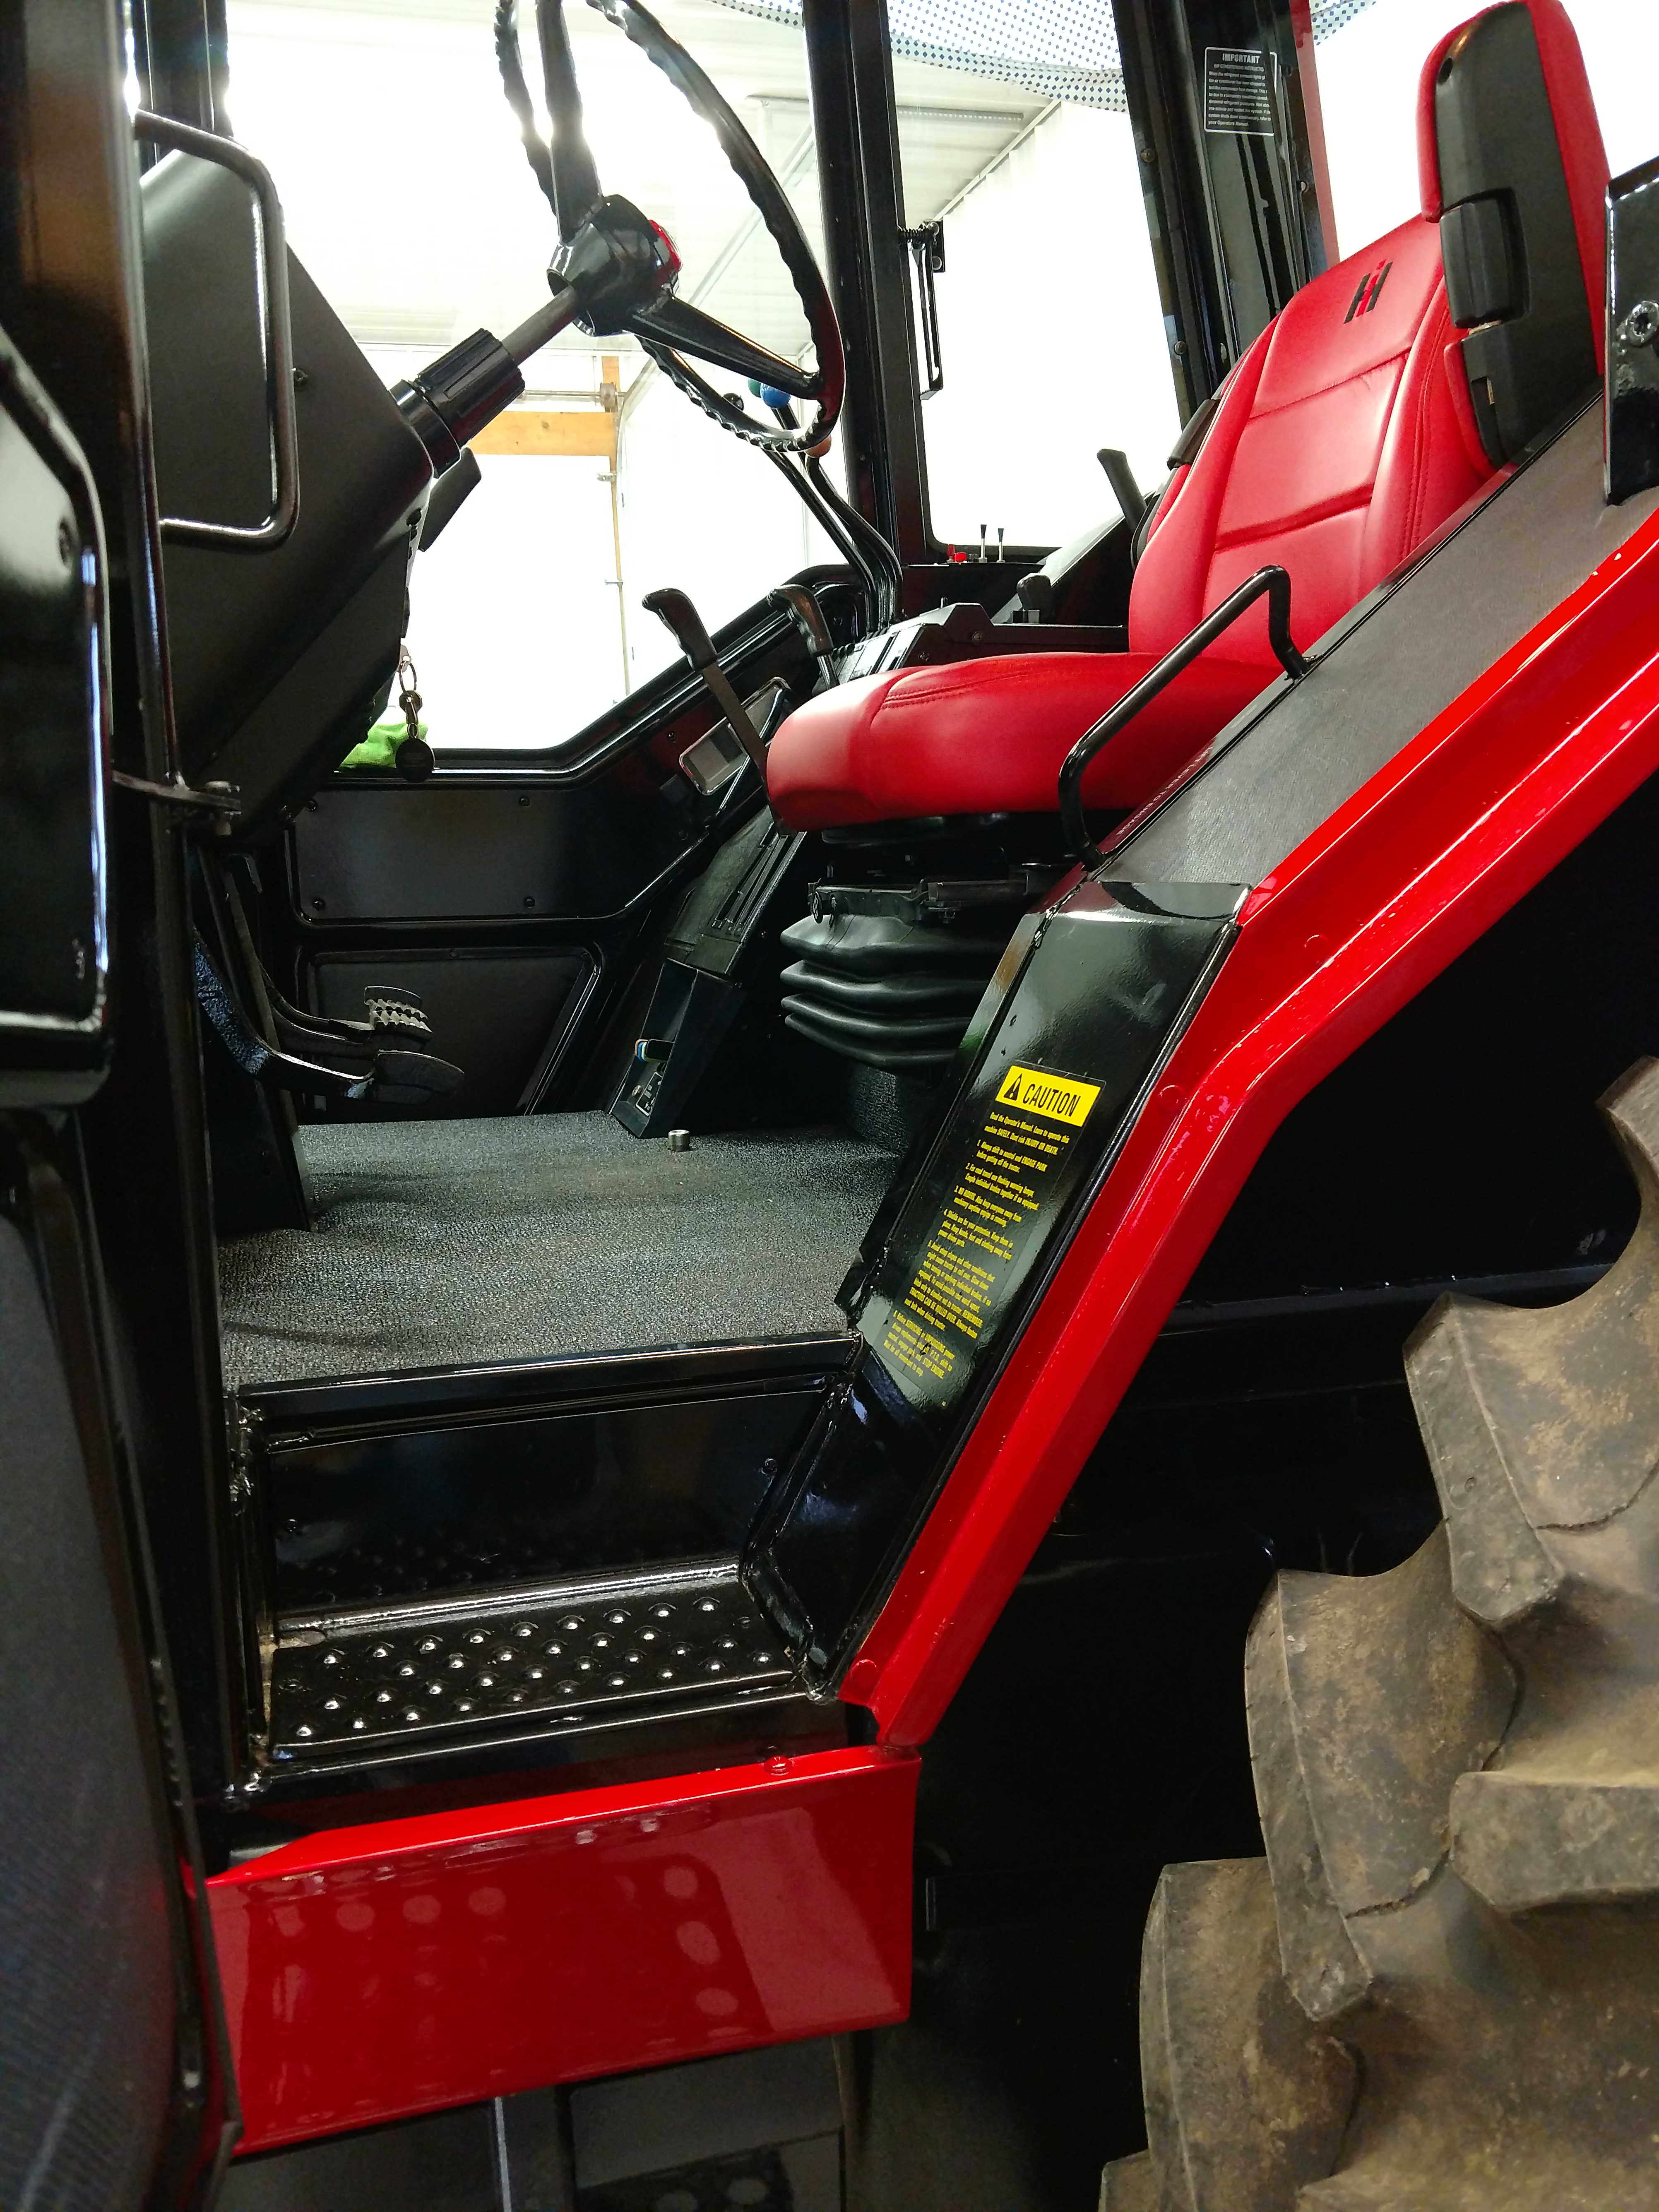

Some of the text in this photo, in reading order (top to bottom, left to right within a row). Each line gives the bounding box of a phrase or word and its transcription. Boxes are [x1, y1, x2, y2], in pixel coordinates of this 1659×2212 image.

[1222, 53, 1260, 63] IMPORTANT
[1165, 764, 1194, 789] LEVER
[1153, 791, 1166, 802] TO
[1116, 802, 1154, 835] ENGAGE
[1022, 1084, 1081, 1117] CAUTION
[1021, 1156, 1037, 1168] ENGAGE
[1035, 1161, 1048, 1172] PARK
